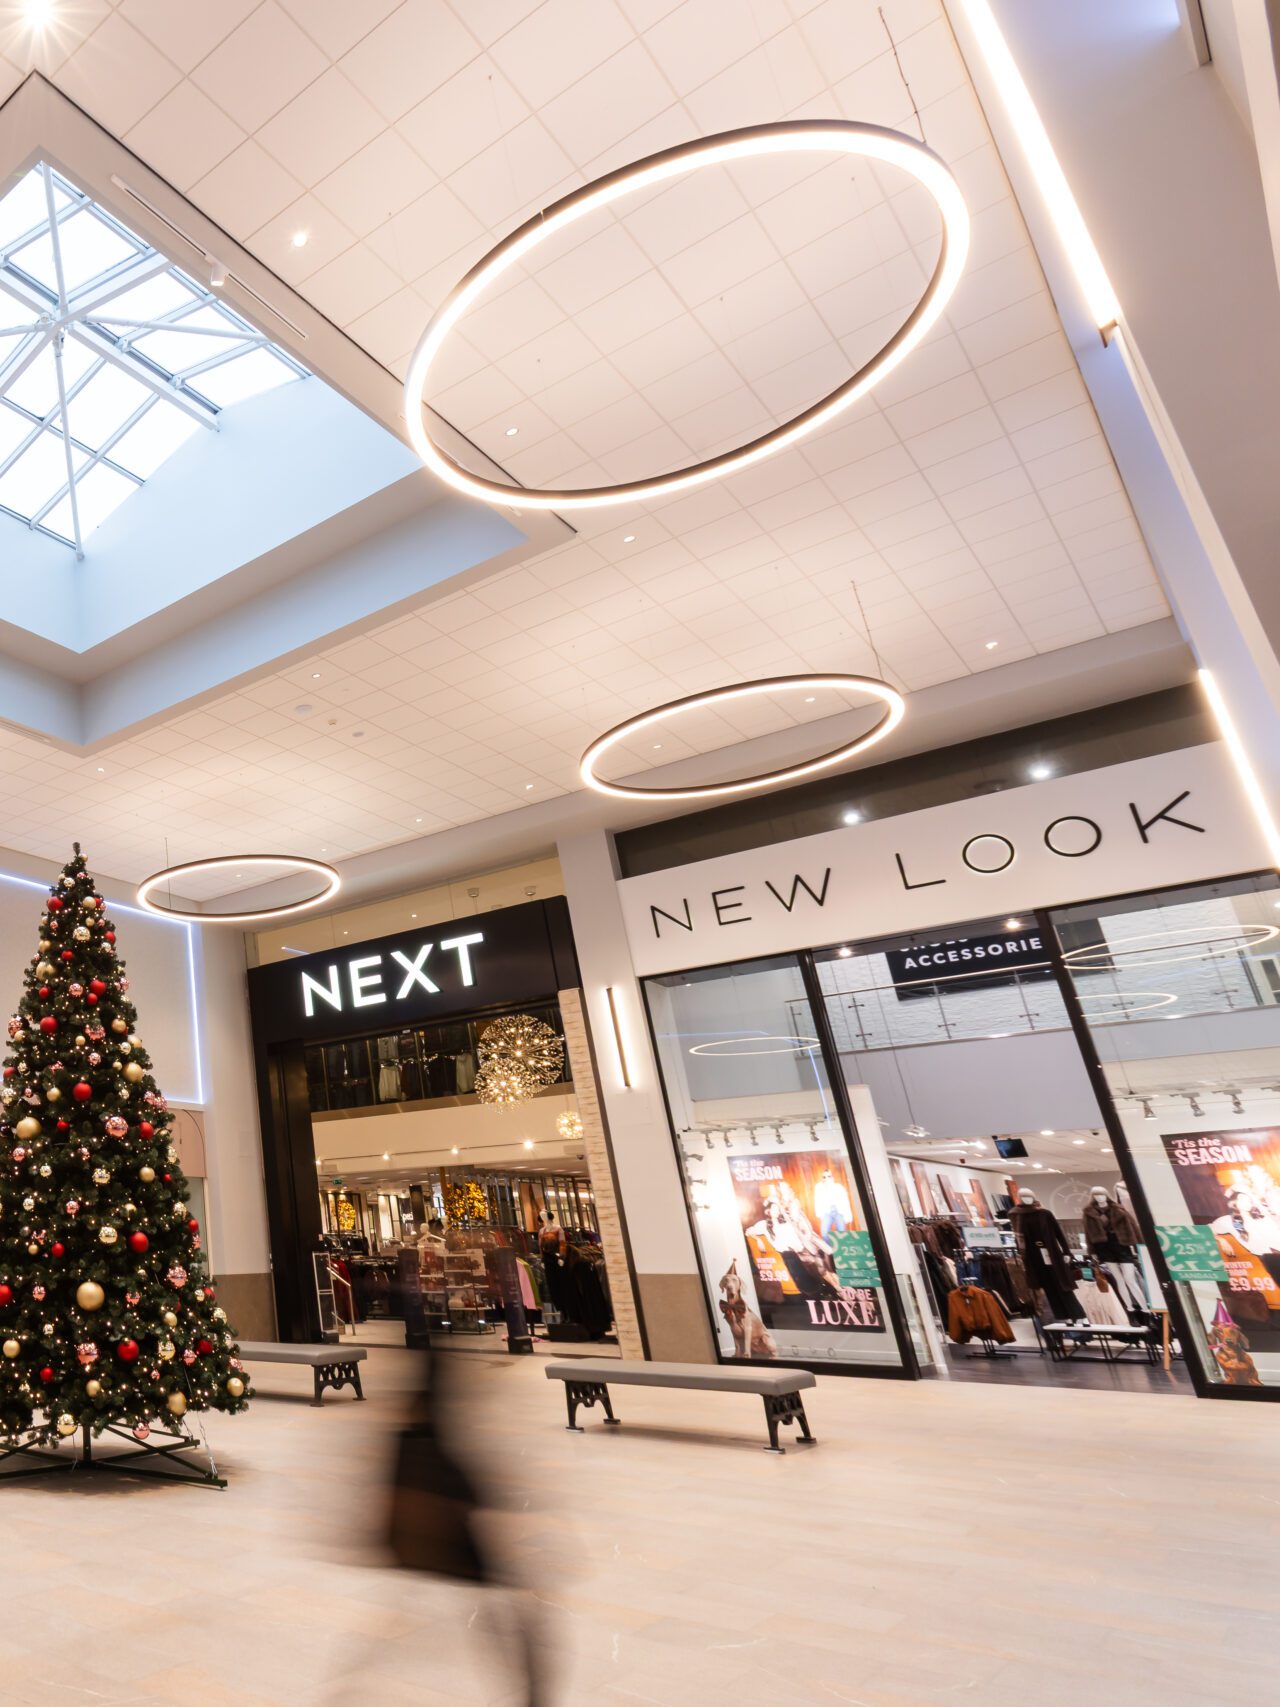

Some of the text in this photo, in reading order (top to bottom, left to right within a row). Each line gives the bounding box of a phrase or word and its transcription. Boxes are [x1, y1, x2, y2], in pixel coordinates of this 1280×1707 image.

[650, 790, 1206, 938] NEW LOOK
[904, 937, 1044, 970] ACCESSORIE
[301, 932, 484, 1018] NEXT
[1198, 1137, 1222, 1147] the
[1174, 1144, 1254, 1167] SEASON
[734, 1165, 784, 1182] SEASON
[856, 1288, 873, 1301] BE
[1229, 1276, 1276, 1292] £9.99
[806, 1299, 880, 1327] LUXE
